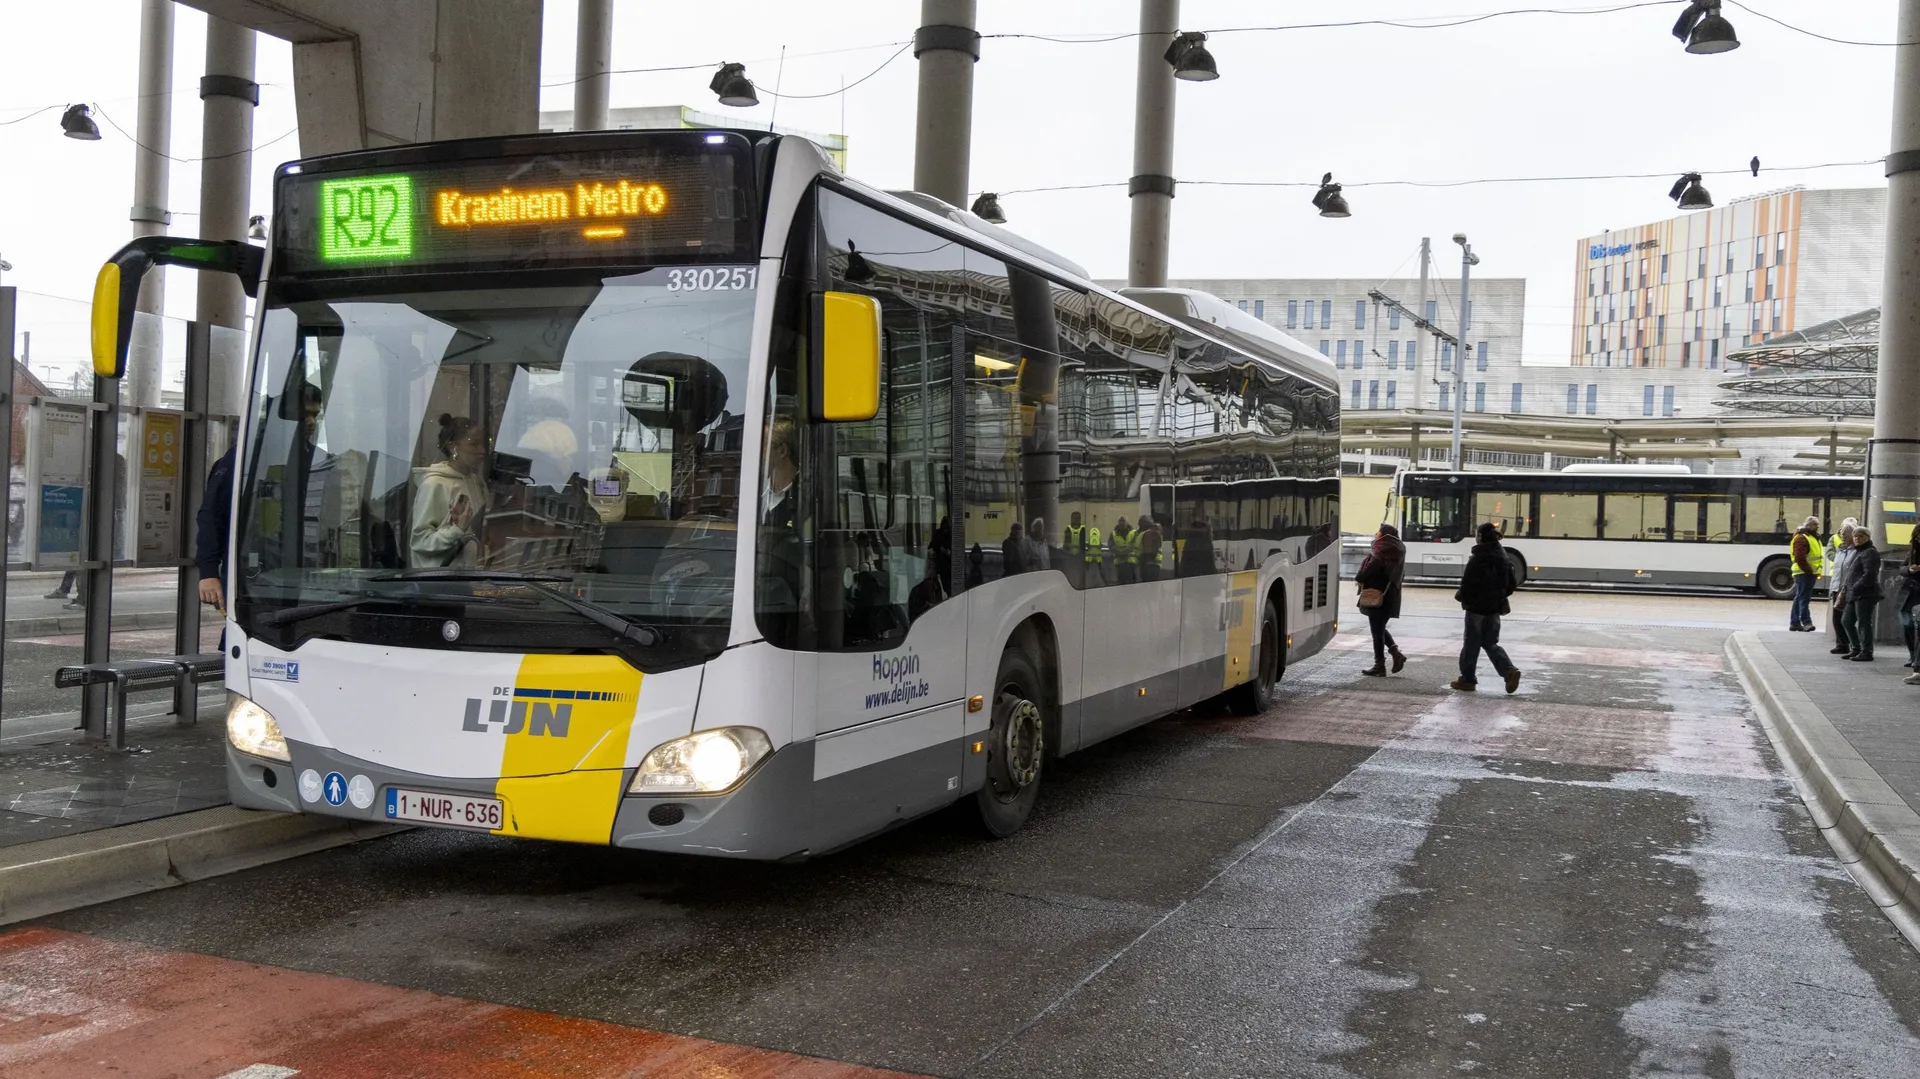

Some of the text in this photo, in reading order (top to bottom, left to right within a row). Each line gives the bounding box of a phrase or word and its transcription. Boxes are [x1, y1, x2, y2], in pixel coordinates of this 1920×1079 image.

[332, 184, 400, 248] R92
[440, 181, 665, 224] Kraainem Metro
[667, 267, 757, 291] 330251
[873, 646, 920, 685] Hoppin
[493, 686, 510, 696] DE
[865, 678, 929, 710] www.delijn.be
[462, 698, 572, 738] LIJN
[388, 804, 395, 814] B
